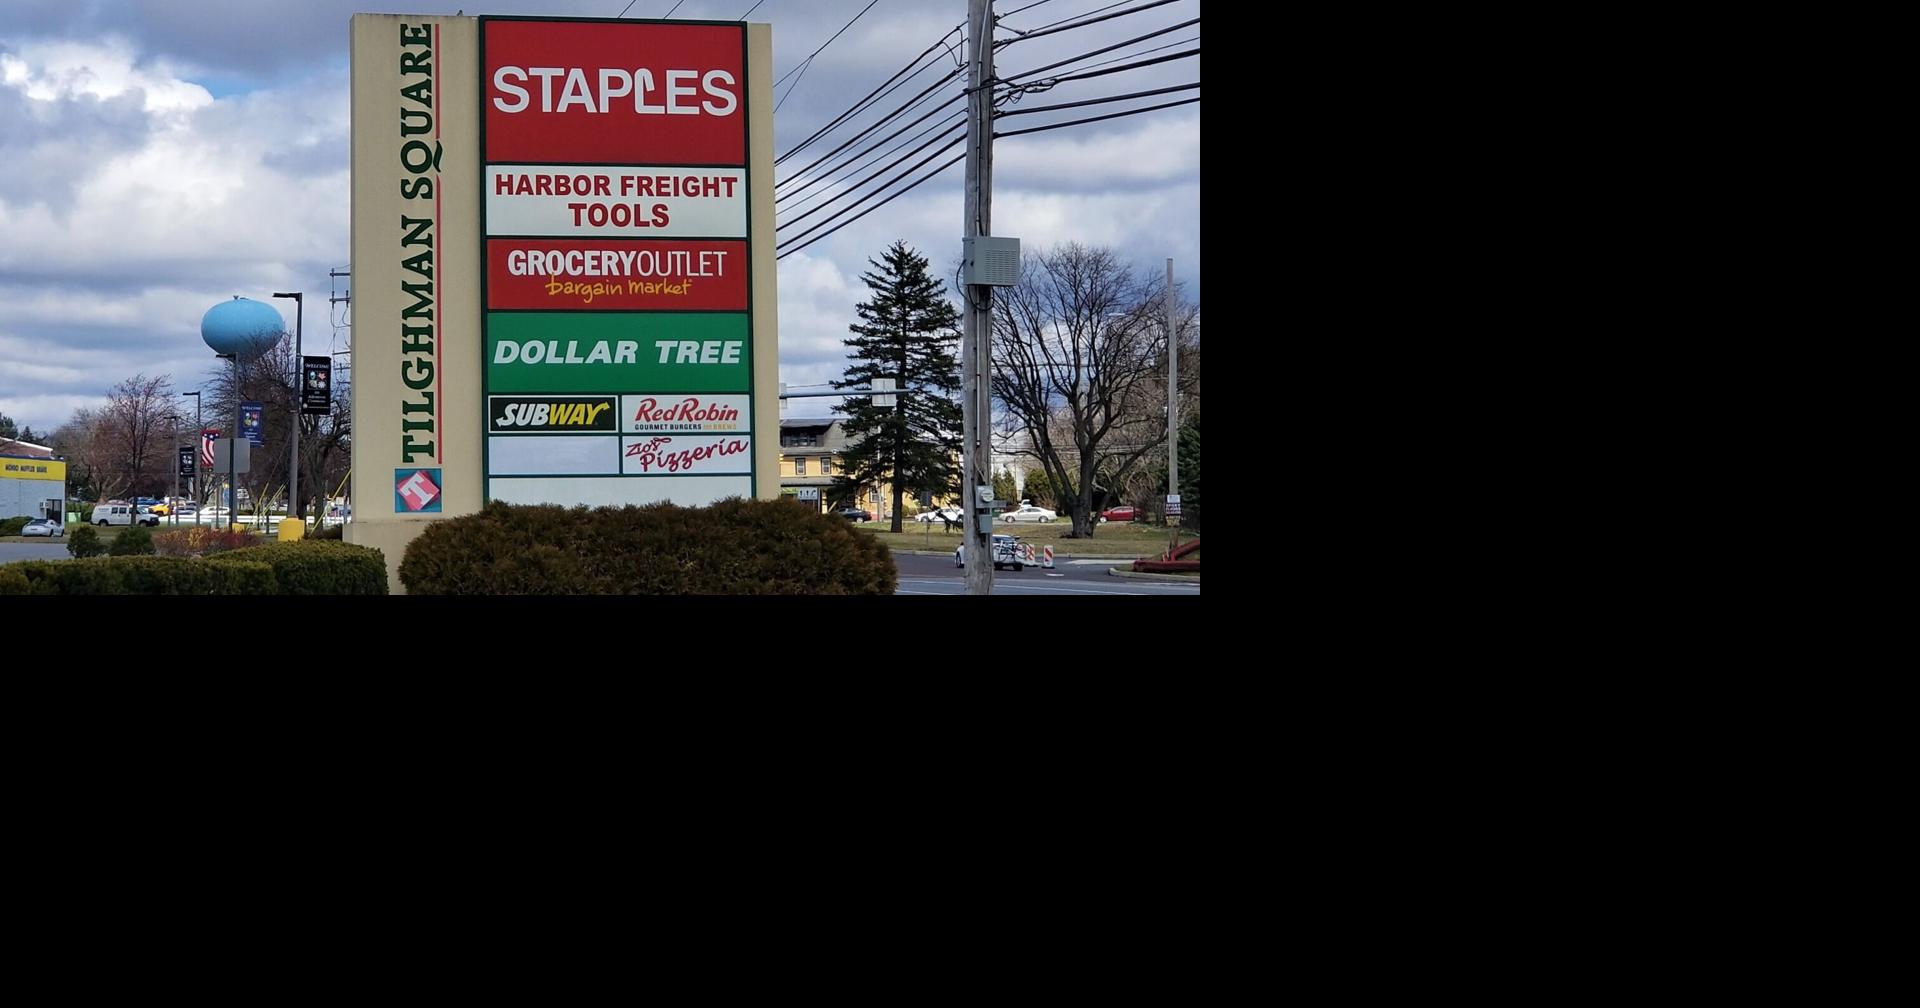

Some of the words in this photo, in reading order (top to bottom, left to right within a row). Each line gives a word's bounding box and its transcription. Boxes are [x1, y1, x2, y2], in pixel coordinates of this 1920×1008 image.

[492, 65, 738, 117] STAPLES
[400, 23, 443, 200] SQUARE
[495, 174, 611, 197] HARBOR
[620, 175, 738, 198] FREIGHT
[568, 203, 670, 228] TOOLS
[545, 272, 623, 304] bargain
[628, 277, 690, 296] market
[401, 214, 435, 464] TILGHMAN
[493, 340, 639, 365] DOLLAR
[655, 340, 743, 364] TREE
[495, 402, 610, 427] SUBWAY
[634, 423, 668, 431] GOURMET
[670, 423, 702, 431] BURGERS
[640, 438, 749, 473] Pizzeria
[400, 472, 434, 506] T
